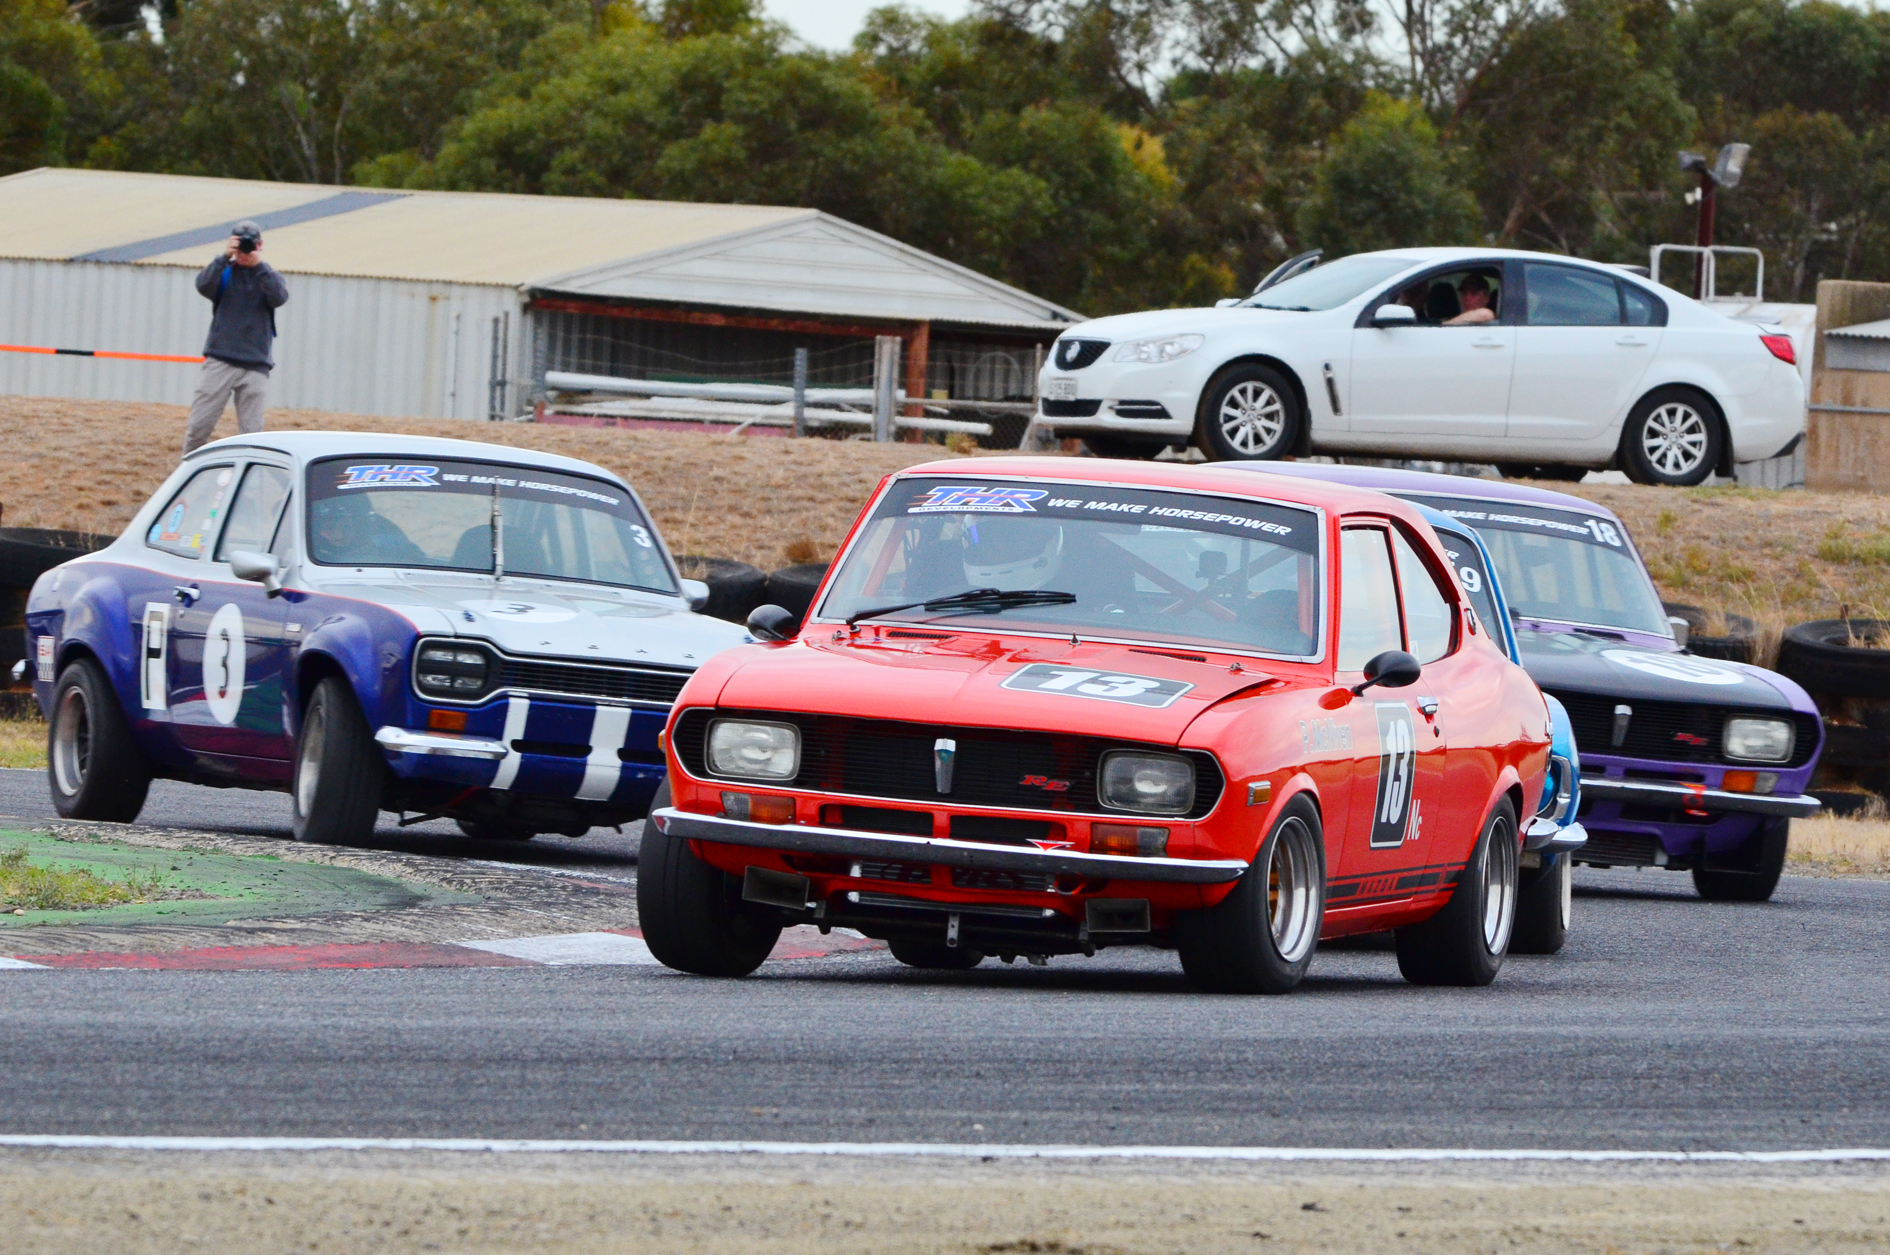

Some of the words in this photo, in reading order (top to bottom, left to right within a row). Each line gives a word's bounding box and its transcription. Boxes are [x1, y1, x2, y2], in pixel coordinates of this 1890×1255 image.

[343, 464, 441, 485] THR
[443, 473, 467, 482] WE
[470, 475, 515, 486] MAKE
[518, 480, 620, 505] HORSEPOWER
[918, 505, 1014, 513] DEVELOPMENTS
[921, 486, 1049, 511] THR
[1047, 498, 1082, 508] WE
[1086, 501, 1146, 514] MAKE
[1149, 506, 1292, 536] HORSEPOWER
[630, 525, 652, 547] 3
[1488, 514, 1590, 535] HORSEPOWER
[1584, 520, 1622, 547] 18
[217, 628, 229, 699] 3
[1037, 671, 1160, 697] 13
[1381, 719, 1410, 824] 13
